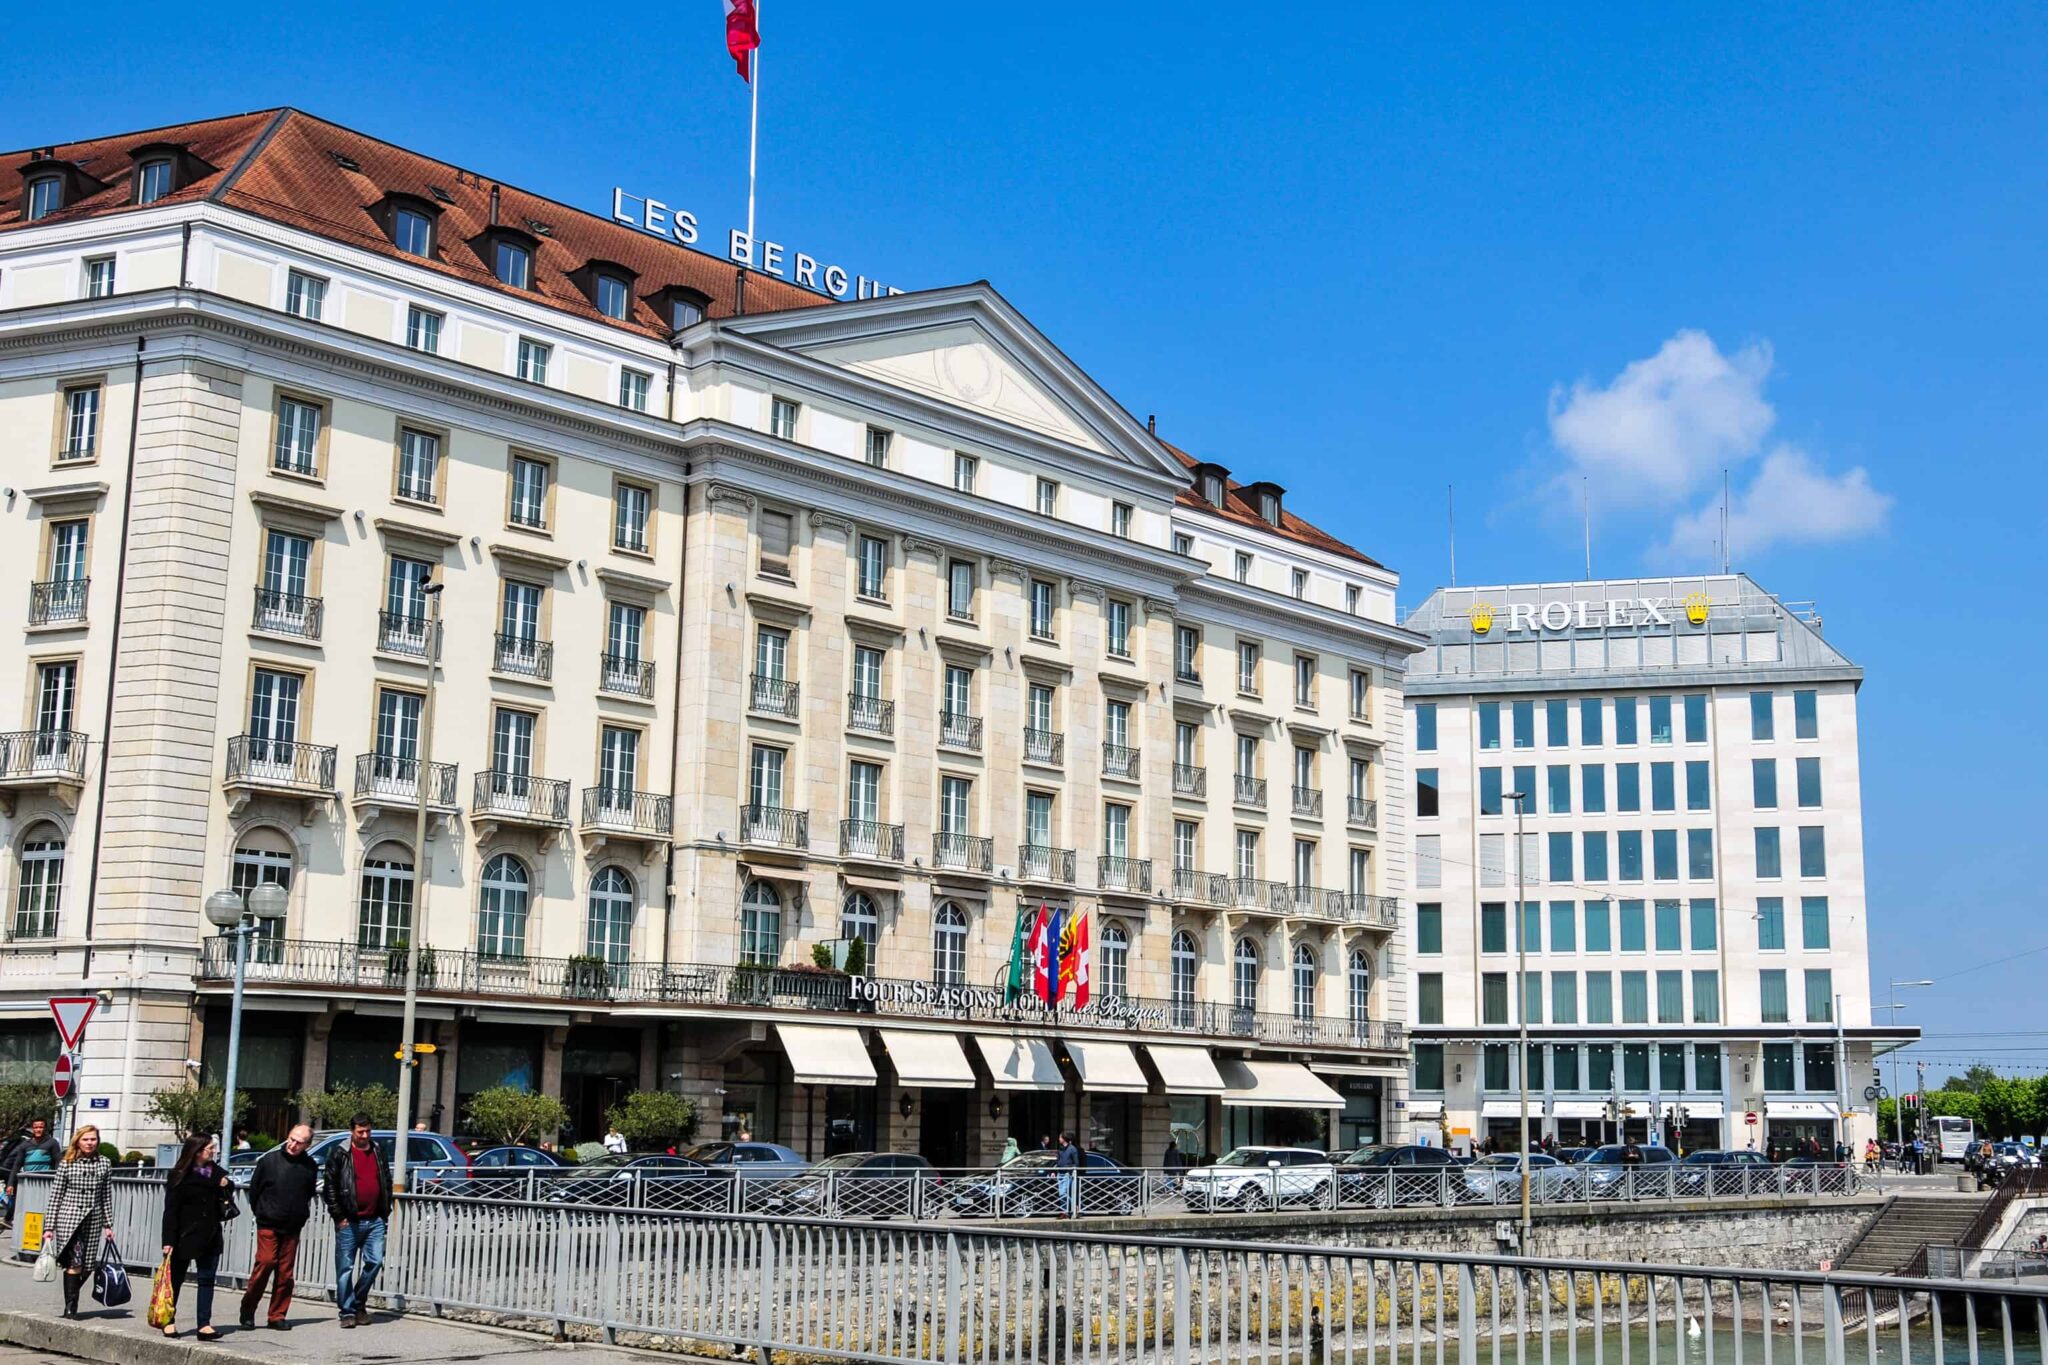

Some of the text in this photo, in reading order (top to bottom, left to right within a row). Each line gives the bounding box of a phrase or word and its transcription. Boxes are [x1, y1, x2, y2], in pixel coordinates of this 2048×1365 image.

[613, 187, 906, 301] LES BERGU
[1507, 597, 1672, 632] ROLEX
[848, 975, 906, 1003] FOUR
[911, 979, 997, 1009] SEASONS
[1099, 994, 1166, 1026] Bergues
